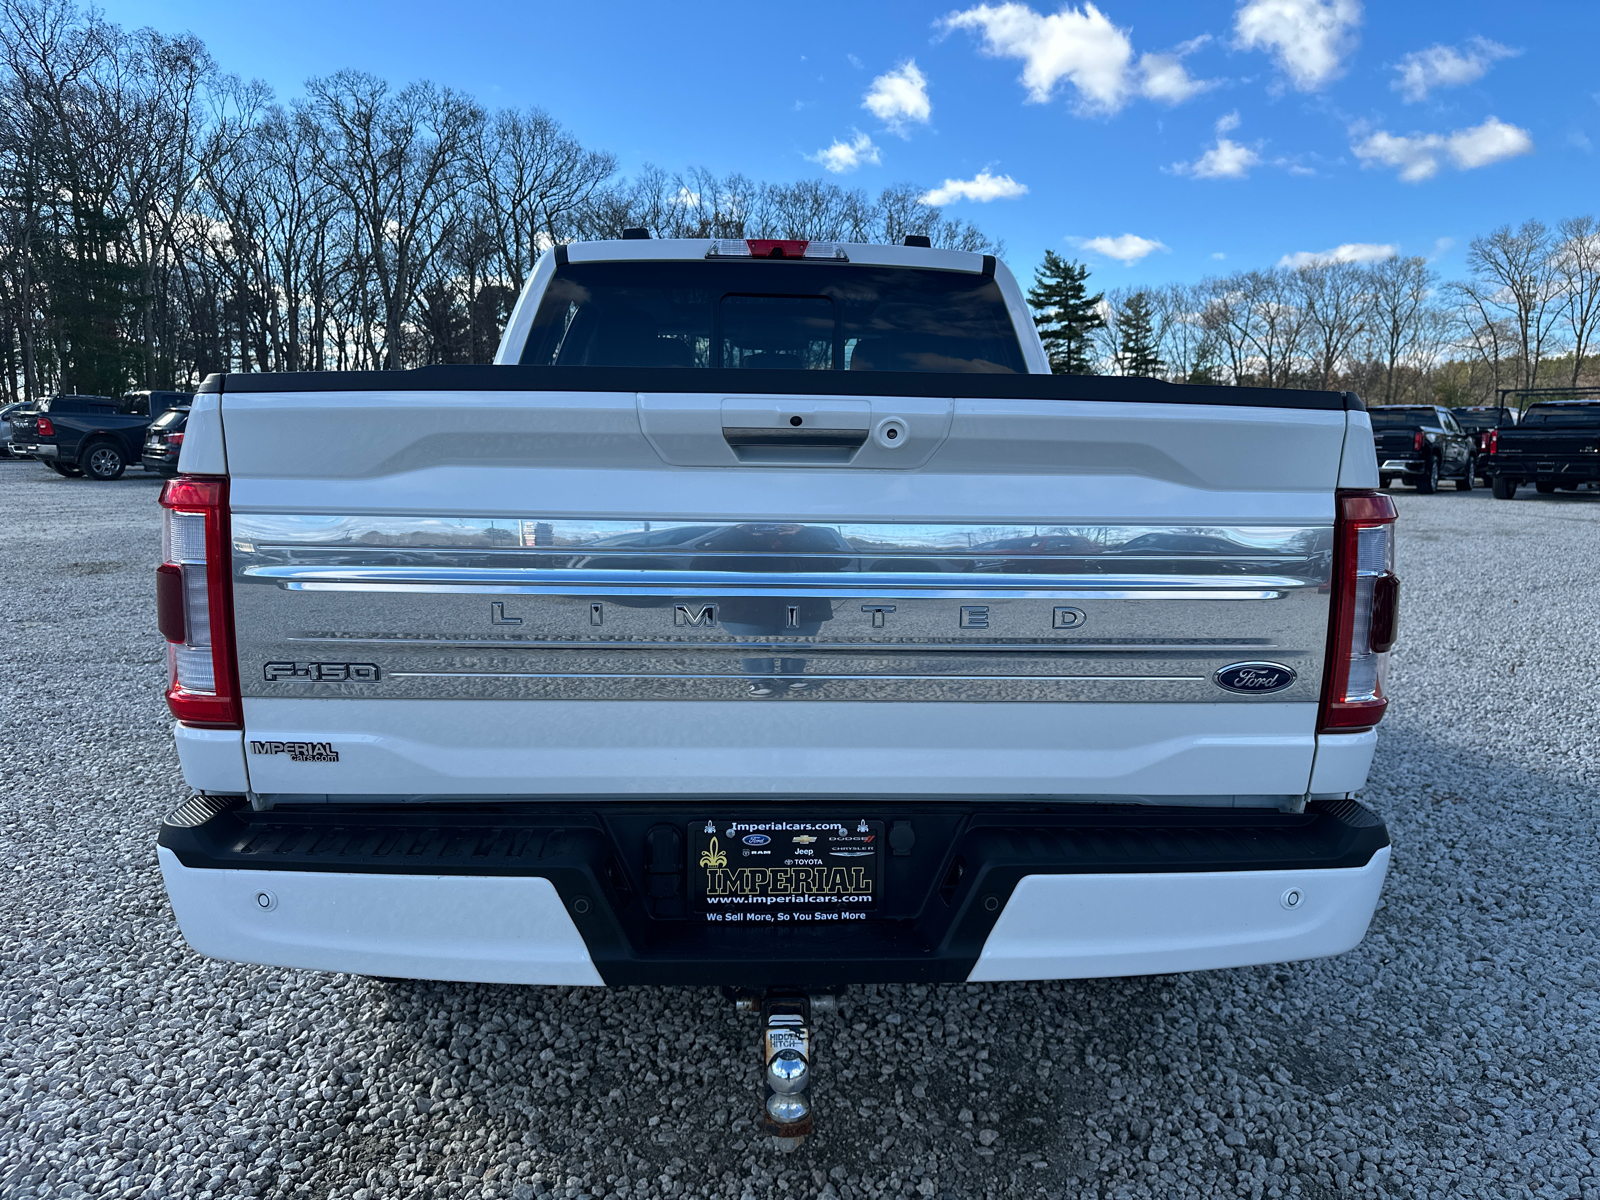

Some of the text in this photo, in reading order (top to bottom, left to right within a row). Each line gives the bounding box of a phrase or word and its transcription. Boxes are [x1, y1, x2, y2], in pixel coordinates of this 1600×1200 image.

[491, 601, 1088, 629] LIMITED
[263, 661, 382, 682] F-150
[250, 741, 338, 756] IMPERIAL
[290, 754, 339, 763] cars.com
[732, 821, 842, 832] Imperialcars.com
[794, 847, 814, 856] Jeep
[706, 867, 872, 894] IMPERIAL
[707, 895, 872, 905] www.imperialcars.com
[706, 912, 866, 922] We Sell More, So You Save More
